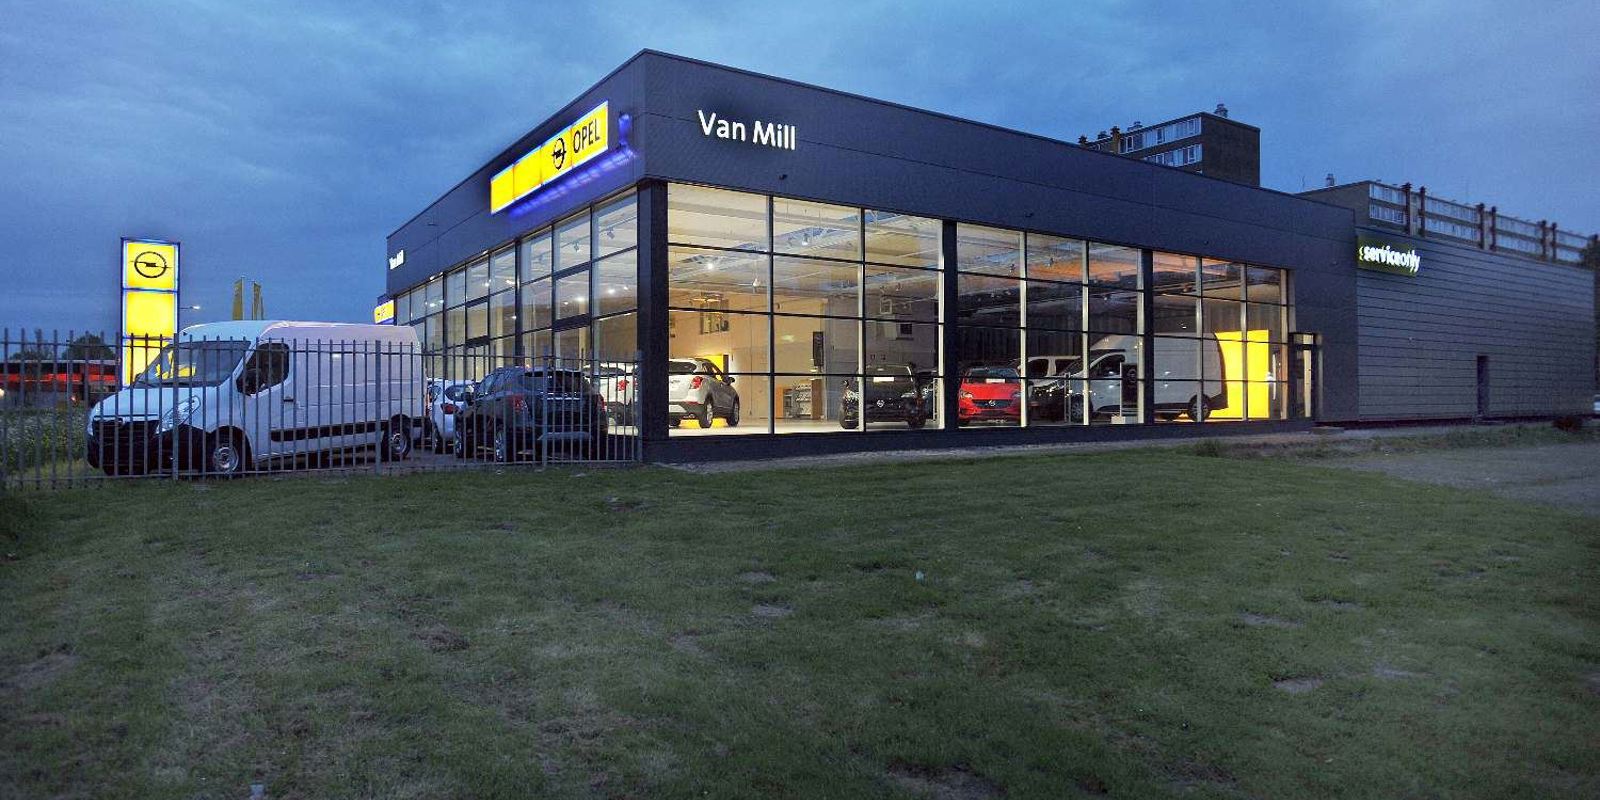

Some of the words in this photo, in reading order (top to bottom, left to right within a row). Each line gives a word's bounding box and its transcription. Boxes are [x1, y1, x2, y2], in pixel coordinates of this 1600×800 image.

[573, 118, 600, 154] OPEL
[698, 110, 746, 141] Van
[752, 121, 796, 150] Mill
